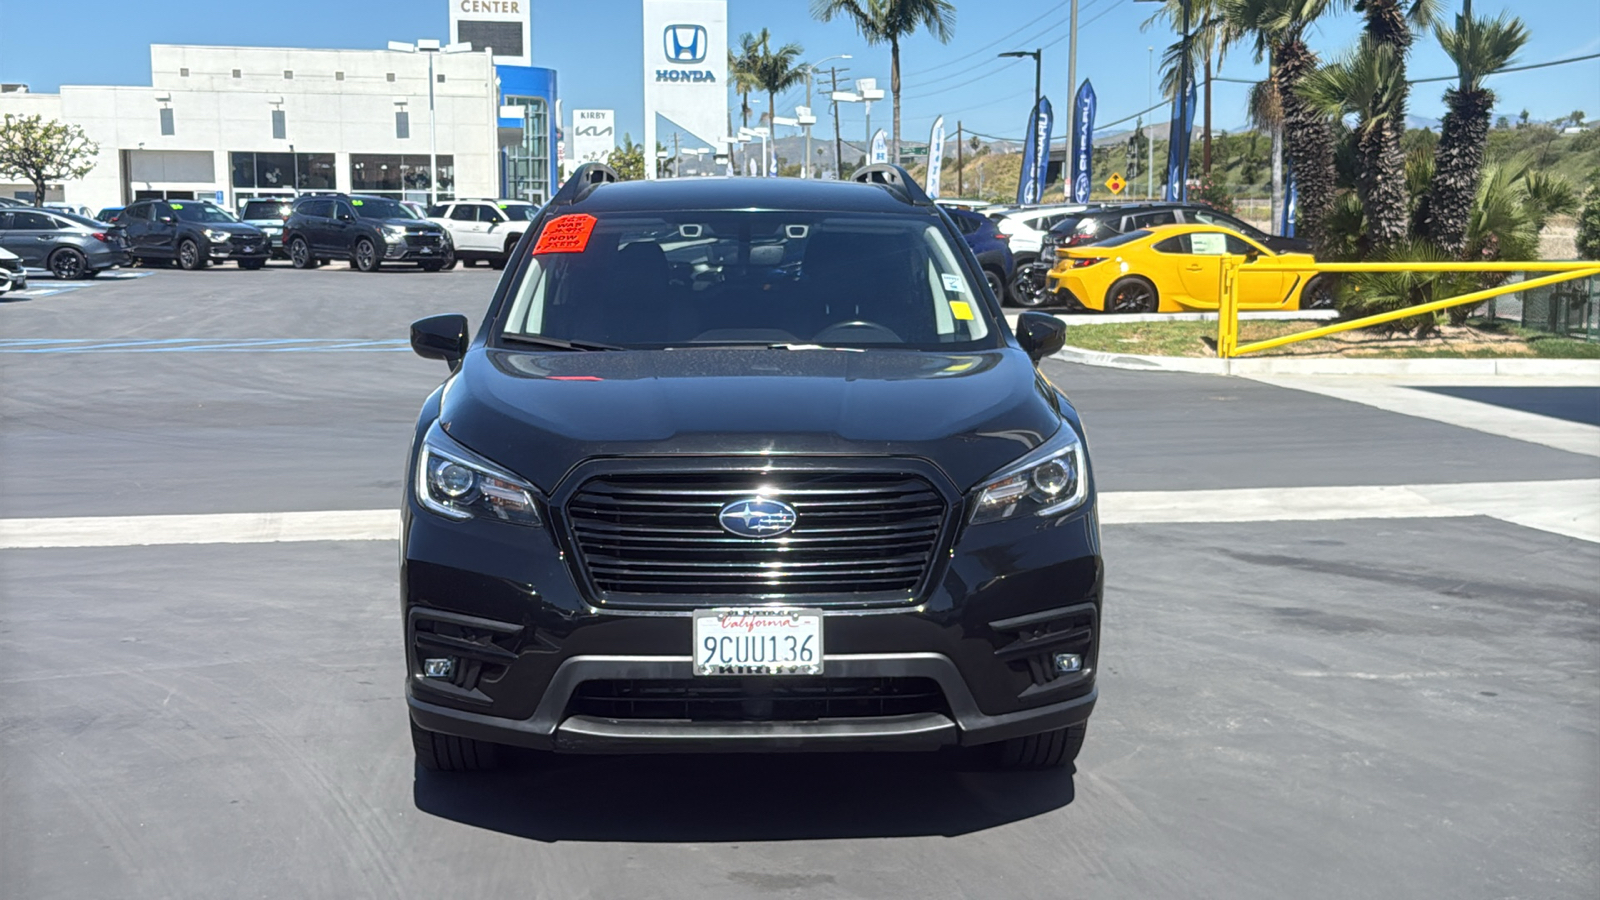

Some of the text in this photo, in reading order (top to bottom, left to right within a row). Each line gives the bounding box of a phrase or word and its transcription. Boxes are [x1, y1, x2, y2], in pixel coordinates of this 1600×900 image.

[461, 0, 520, 13] CENTER
[655, 69, 716, 82] HONDA
[720, 614, 799, 632] California
[704, 634, 814, 664] 9CUU136
